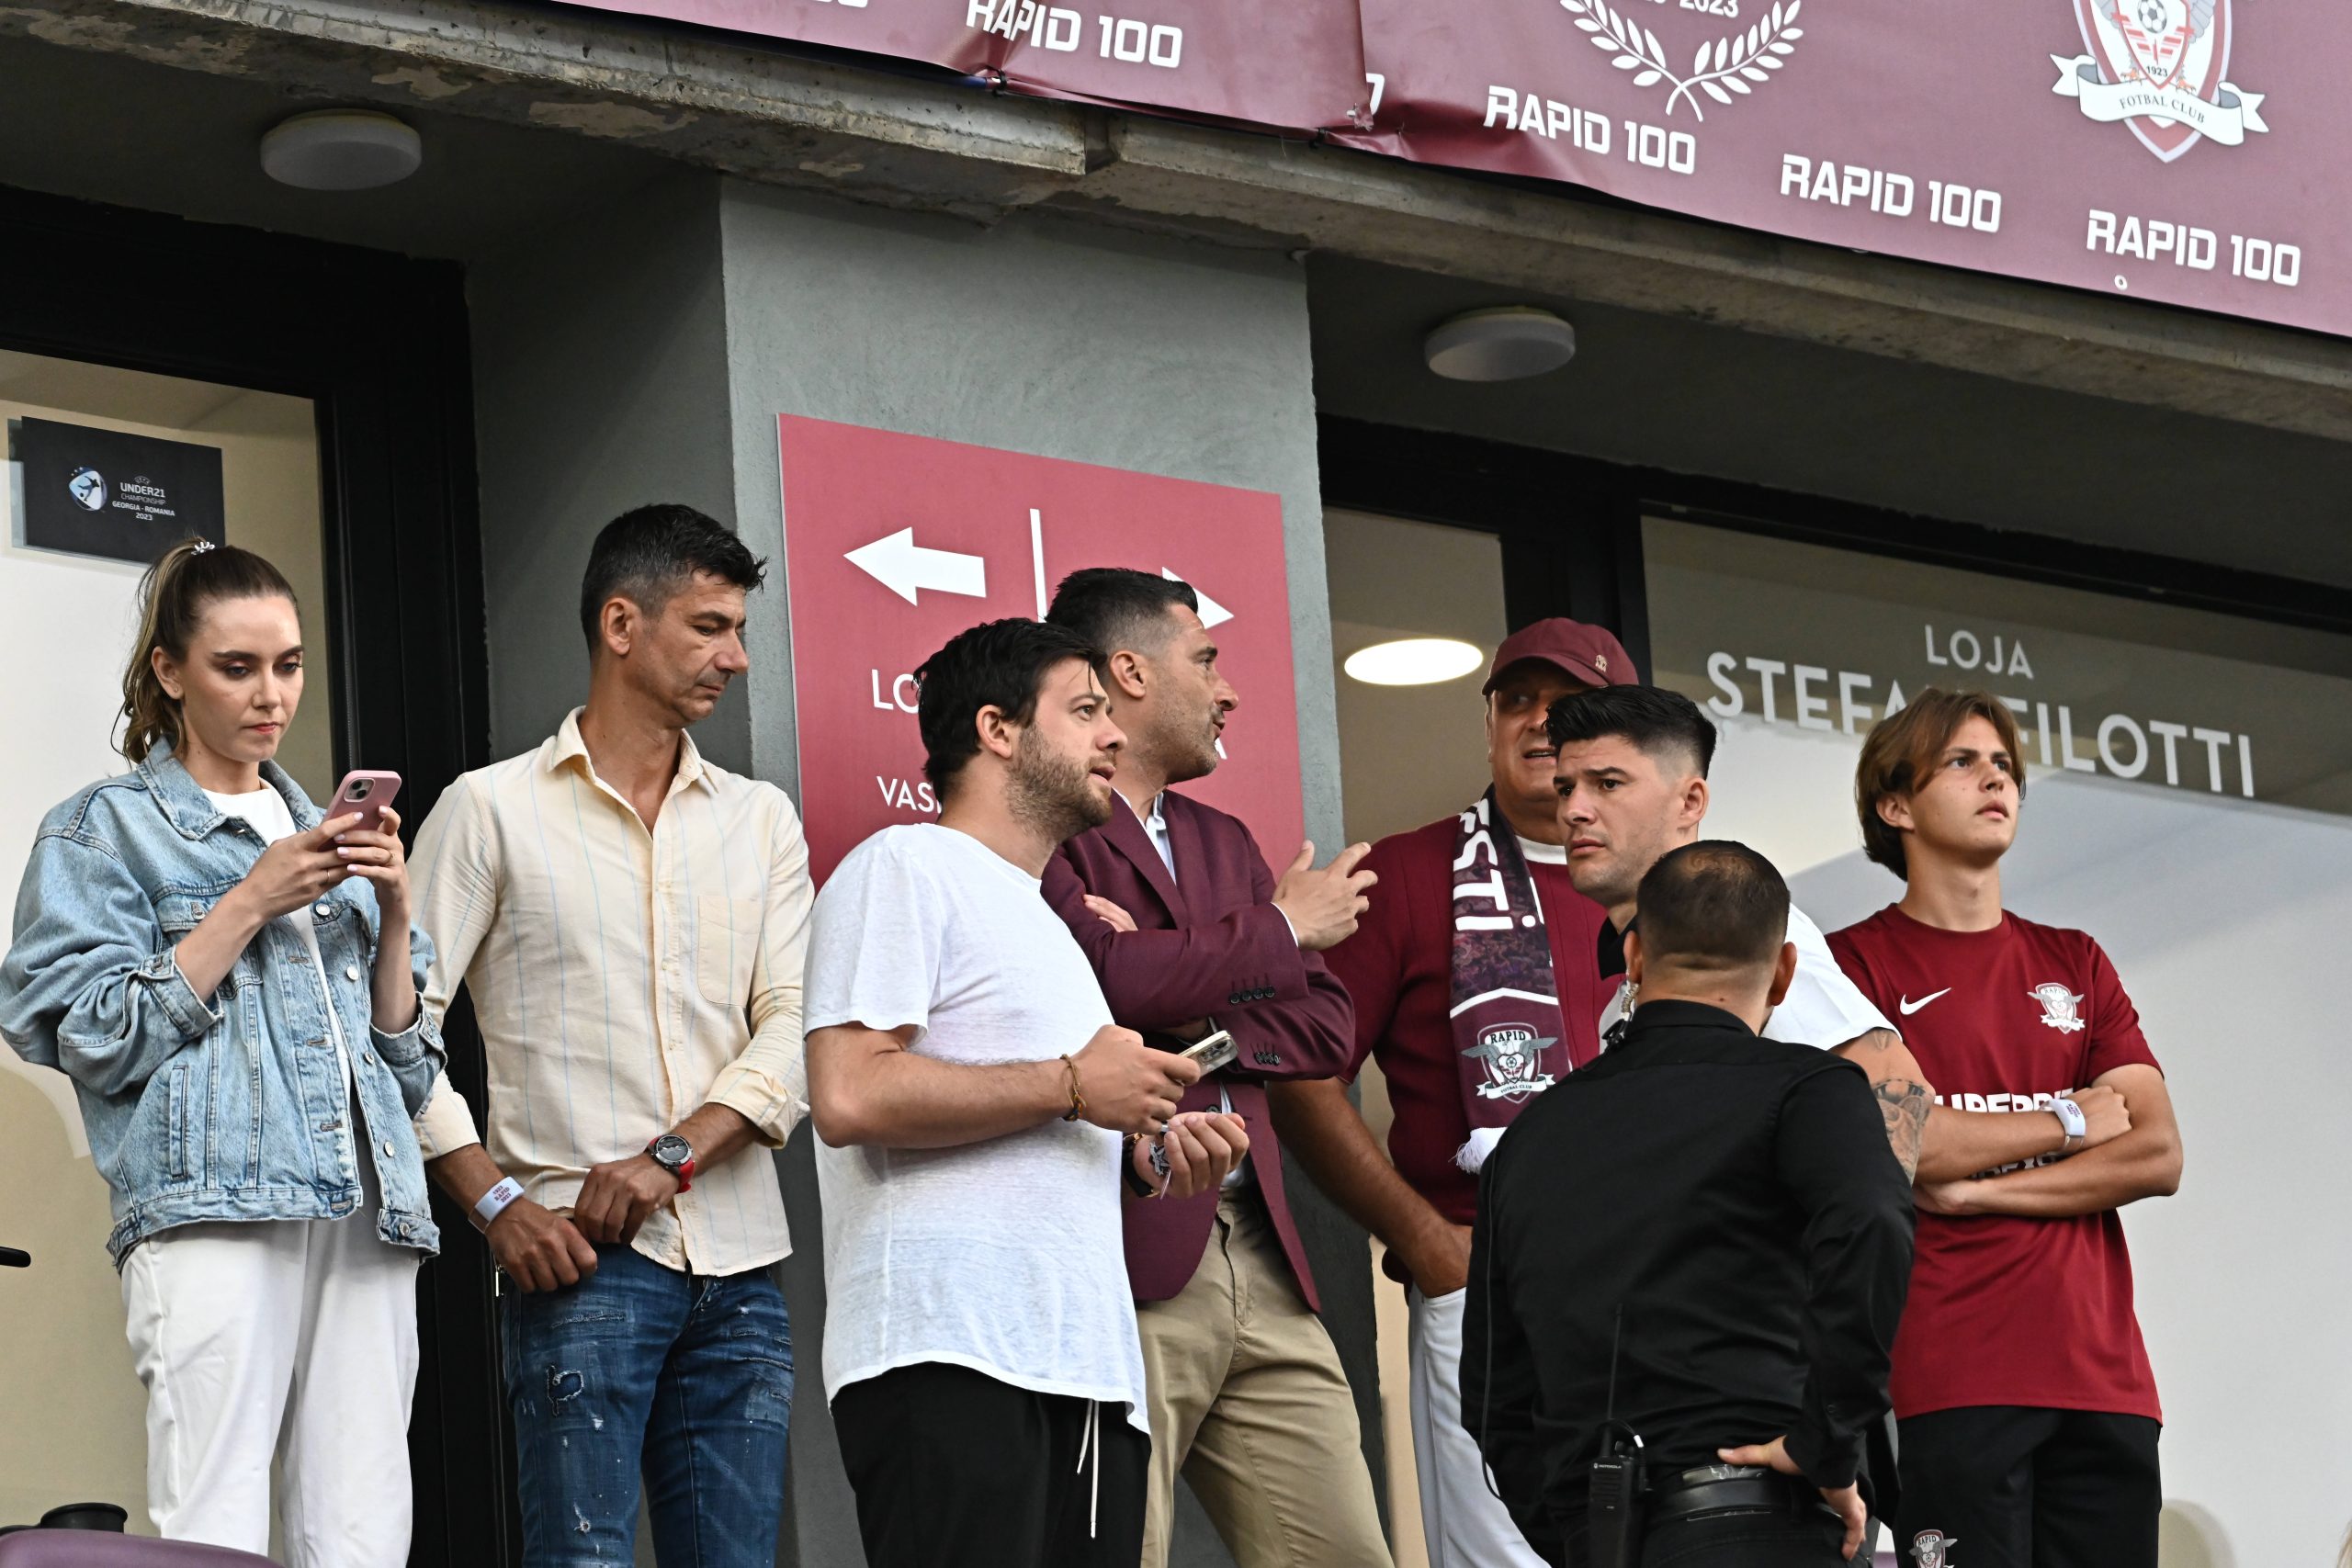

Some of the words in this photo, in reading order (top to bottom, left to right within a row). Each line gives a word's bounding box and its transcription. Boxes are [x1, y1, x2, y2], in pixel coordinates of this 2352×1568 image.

[1099, 15, 1182, 68] 100
[2146, 65, 2168, 77] 1923
[2119, 94, 2168, 109] FOTBAL
[2171, 98, 2206, 123] CLUB
[1483, 85, 1611, 154] RAPID
[1624, 120, 1696, 175] 100
[1780, 153, 1915, 217] RAPID
[1928, 180, 2002, 233] 100
[2086, 209, 2217, 270] RAPID
[2230, 234, 2301, 287] 100
[120, 482, 165, 498] UNDER21
[121, 493, 165, 505] CHAMPIONSHIP
[112, 501, 141, 511] GEORGIA
[144, 505, 175, 516] ROMANIA
[135, 513, 153, 521] 2023
[1925, 625, 2034, 680] LOJA
[1490, 1031, 1526, 1043] RAPID
